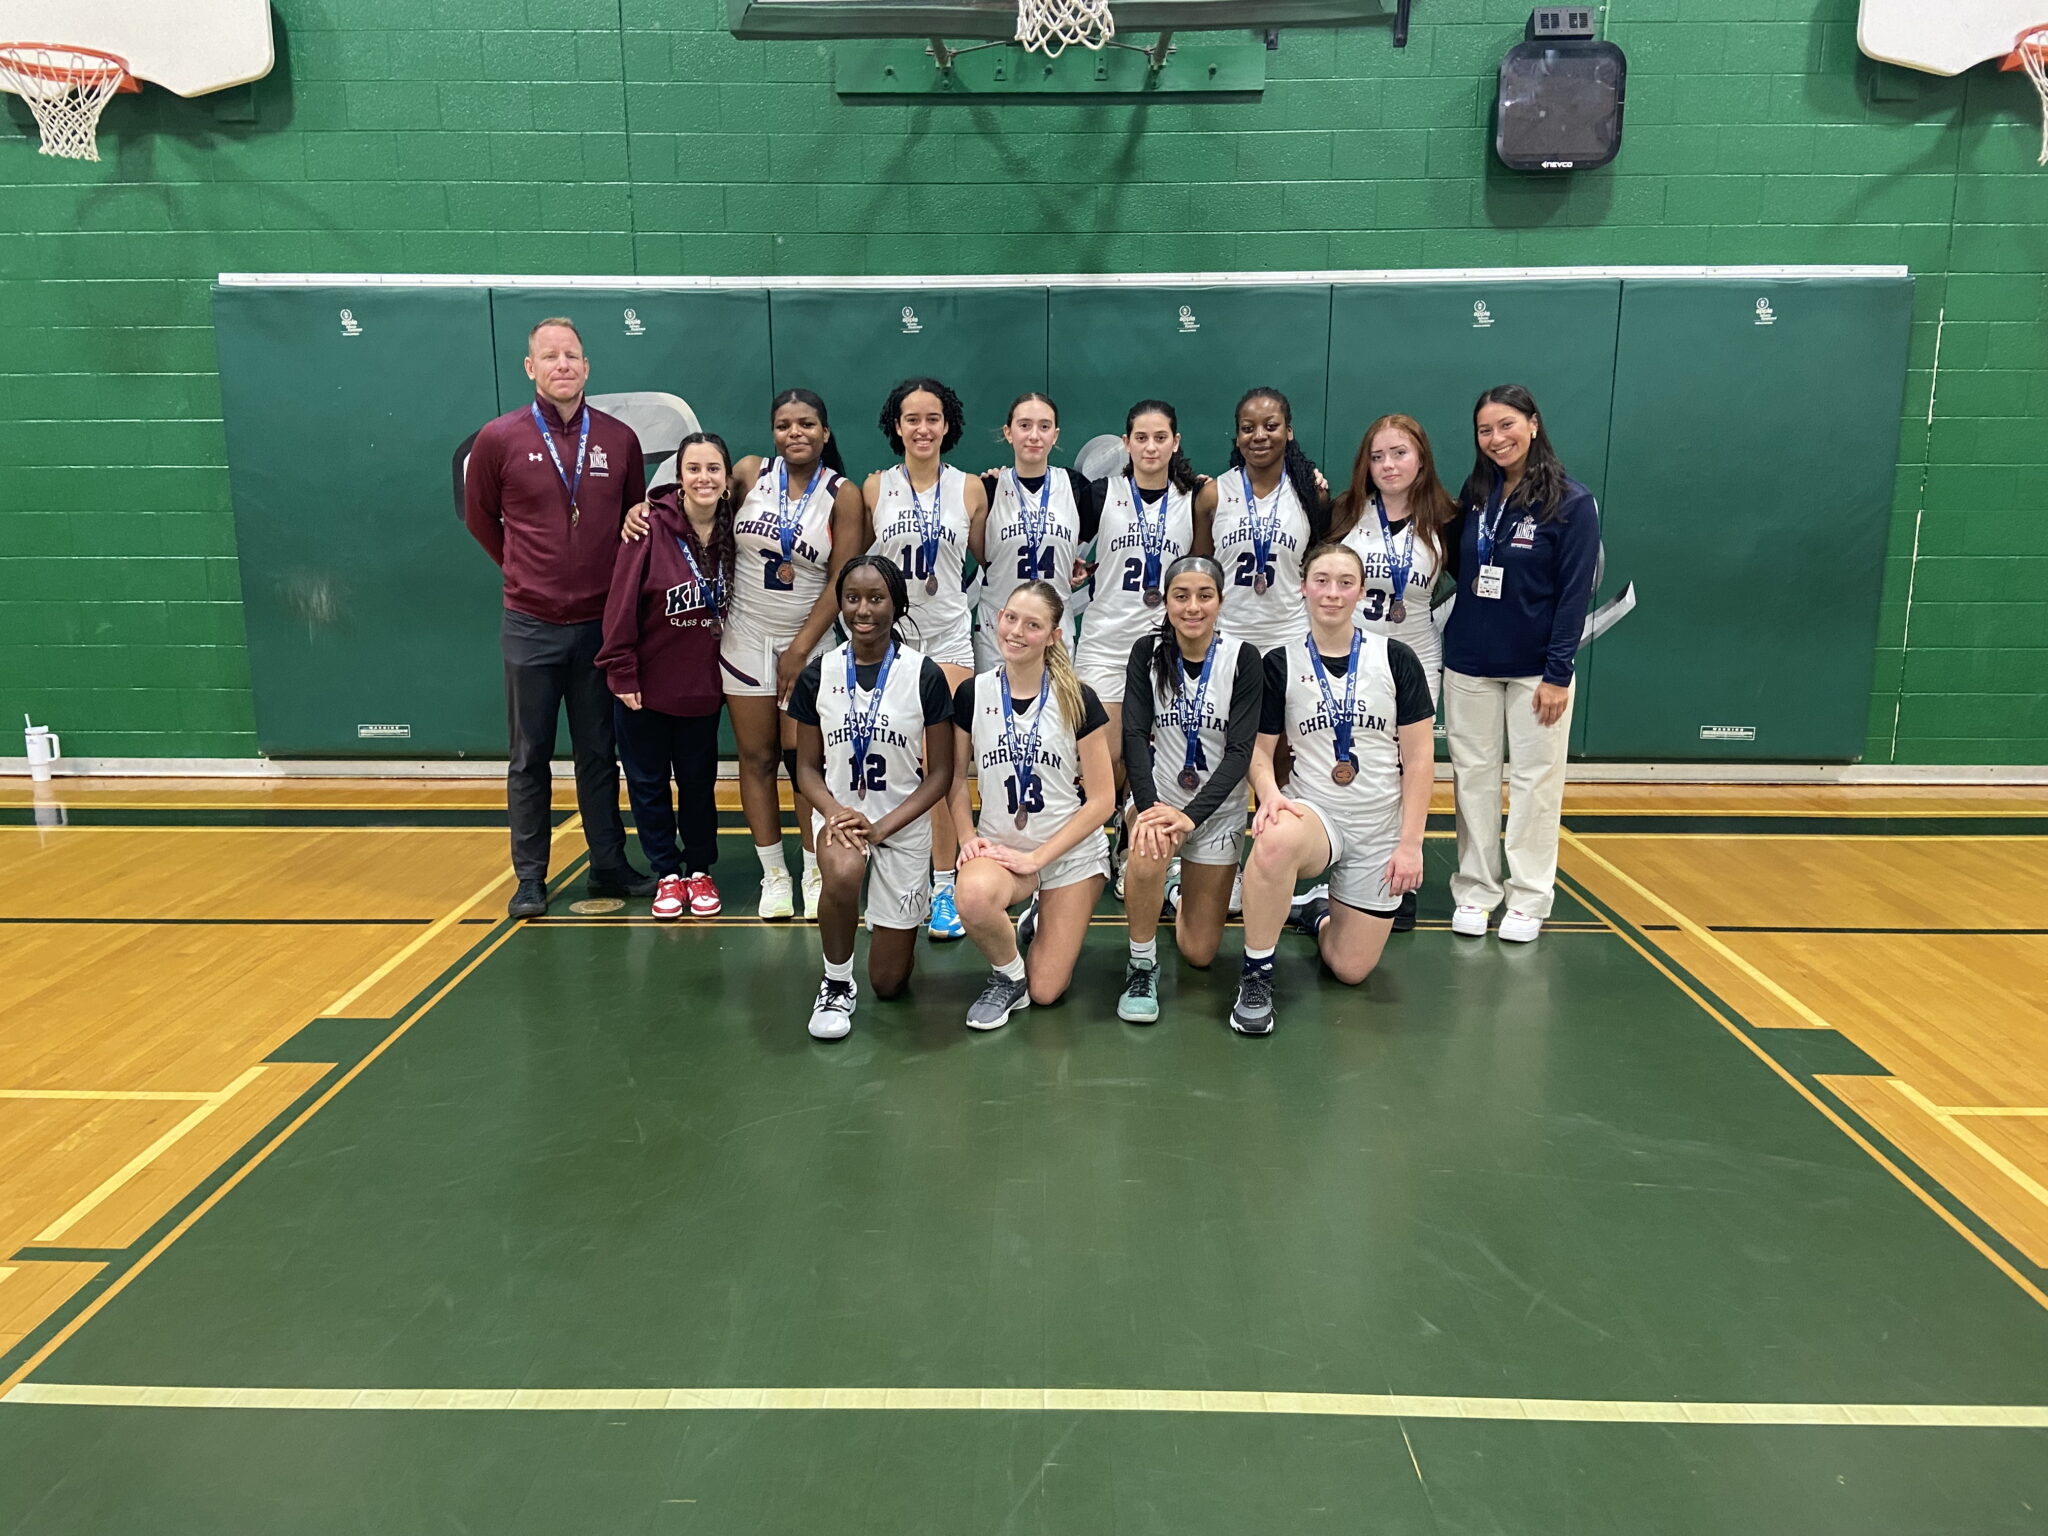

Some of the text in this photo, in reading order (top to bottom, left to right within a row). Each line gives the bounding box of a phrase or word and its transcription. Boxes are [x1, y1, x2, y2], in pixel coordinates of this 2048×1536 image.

[735, 520, 820, 564] CHRISIAN
[882, 520, 957, 546] CHRISAN
[758, 548, 793, 591] 2
[1017, 545, 1055, 579] 24
[1234, 552, 1277, 588] 25
[670, 617, 698, 627] CLASS
[700, 618, 713, 628] OF
[849, 753, 887, 792] 12
[1004, 774, 1045, 815] 13
